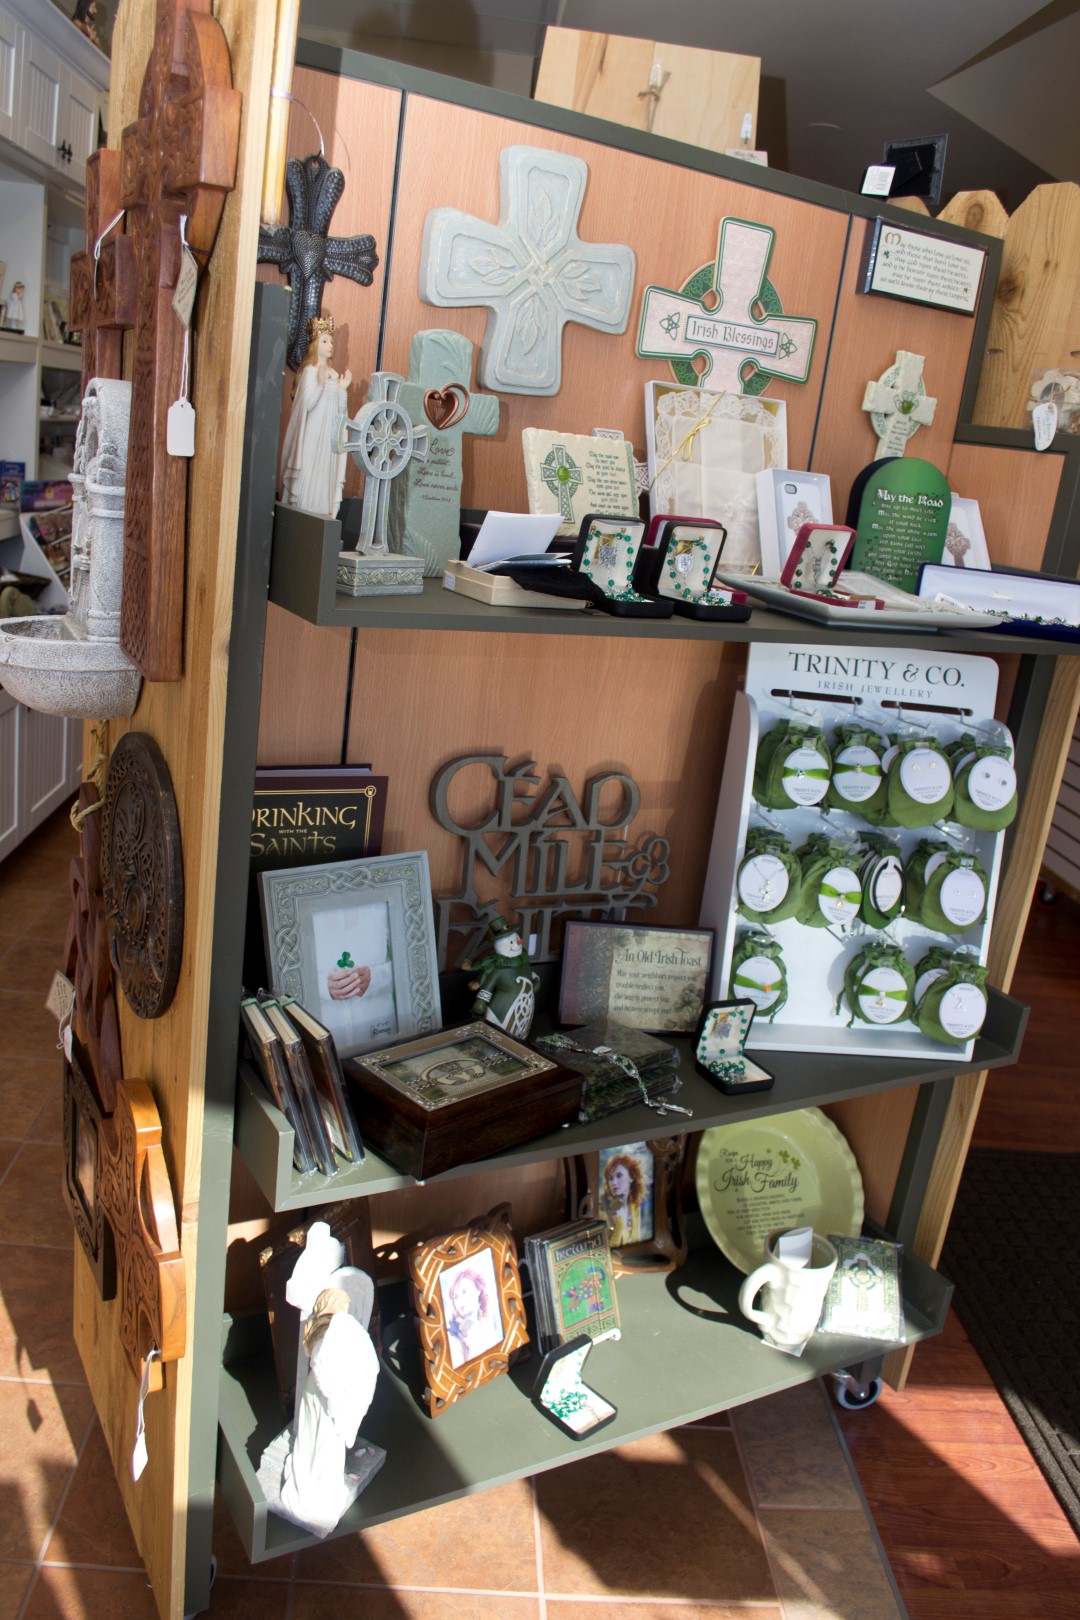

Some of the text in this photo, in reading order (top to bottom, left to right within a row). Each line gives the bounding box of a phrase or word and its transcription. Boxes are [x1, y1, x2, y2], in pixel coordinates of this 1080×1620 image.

[692, 320, 774, 351] Irish Blessings
[429, 438, 455, 457] Love
[877, 488, 944, 508] May the Road
[788, 651, 965, 687] TRINITY & CO.
[818, 680, 933, 699] IRISH JEWELLERY
[251, 801, 358, 830] RINKING
[637, 949, 653, 963] Old
[655, 950, 677, 968] Irish
[675, 947, 701, 967] Toast
[735, 1153, 773, 1172] Happy
[714, 1167, 798, 1194] Irish Family
